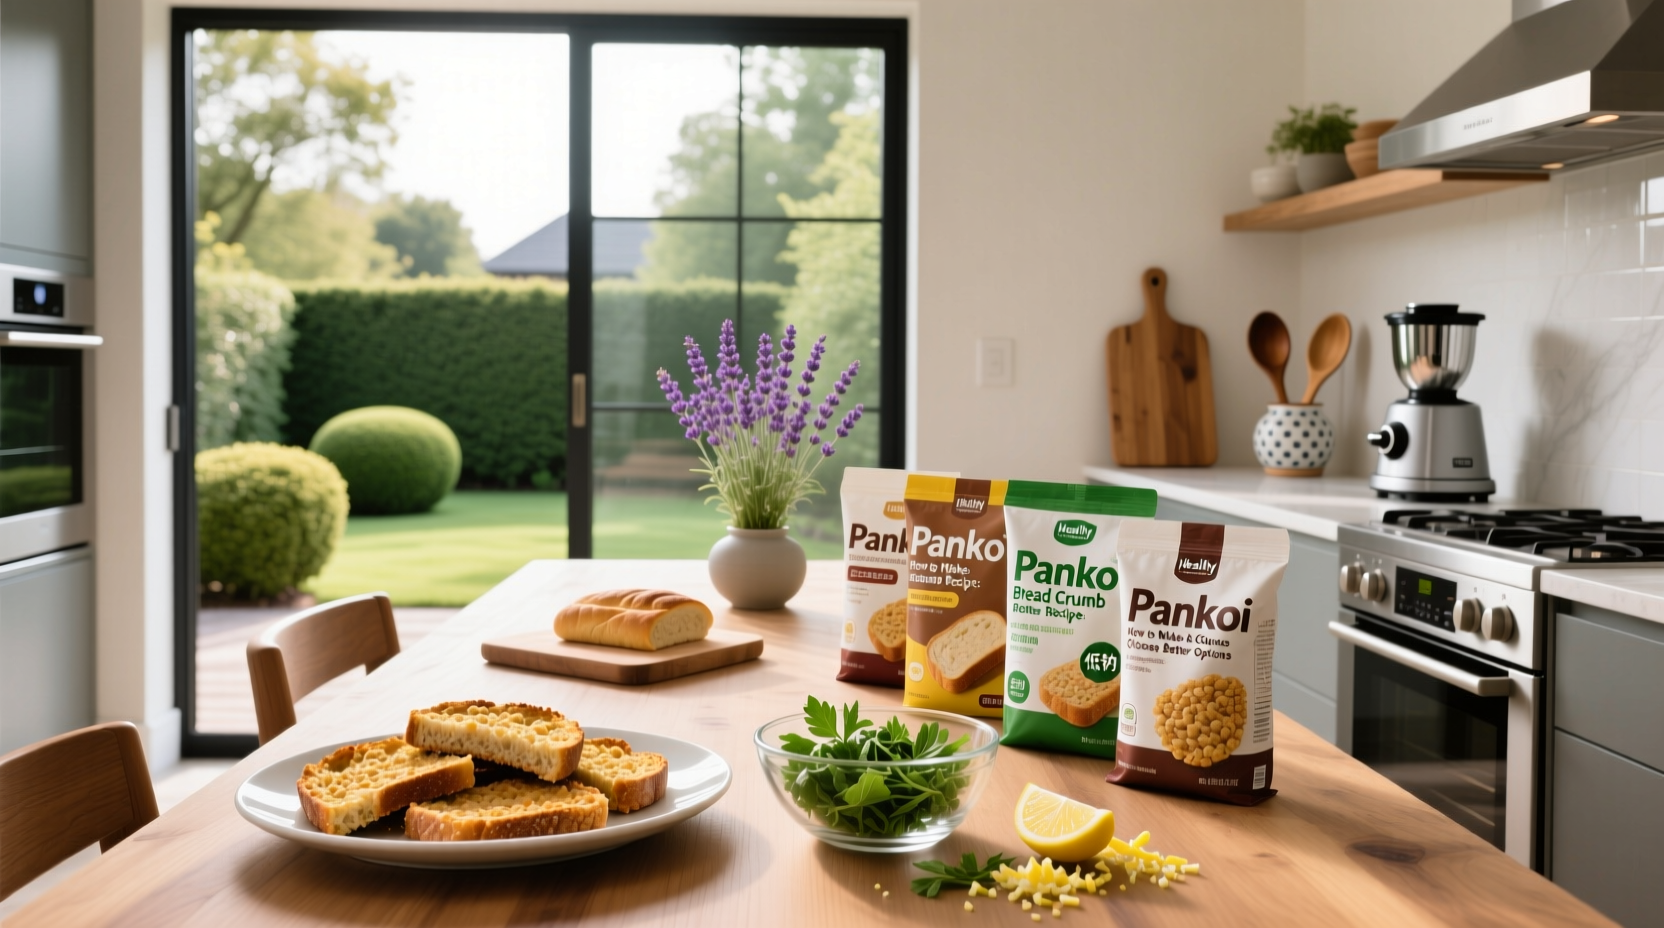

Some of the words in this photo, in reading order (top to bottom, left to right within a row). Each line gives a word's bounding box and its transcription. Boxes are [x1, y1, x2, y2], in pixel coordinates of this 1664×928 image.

[910, 526, 1004, 562] Panko
[1014, 550, 1119, 591] Panko
[1013, 586, 1051, 604] Bread
[1055, 591, 1106, 609] Crumb
[1128, 588, 1253, 633] Pankoi
